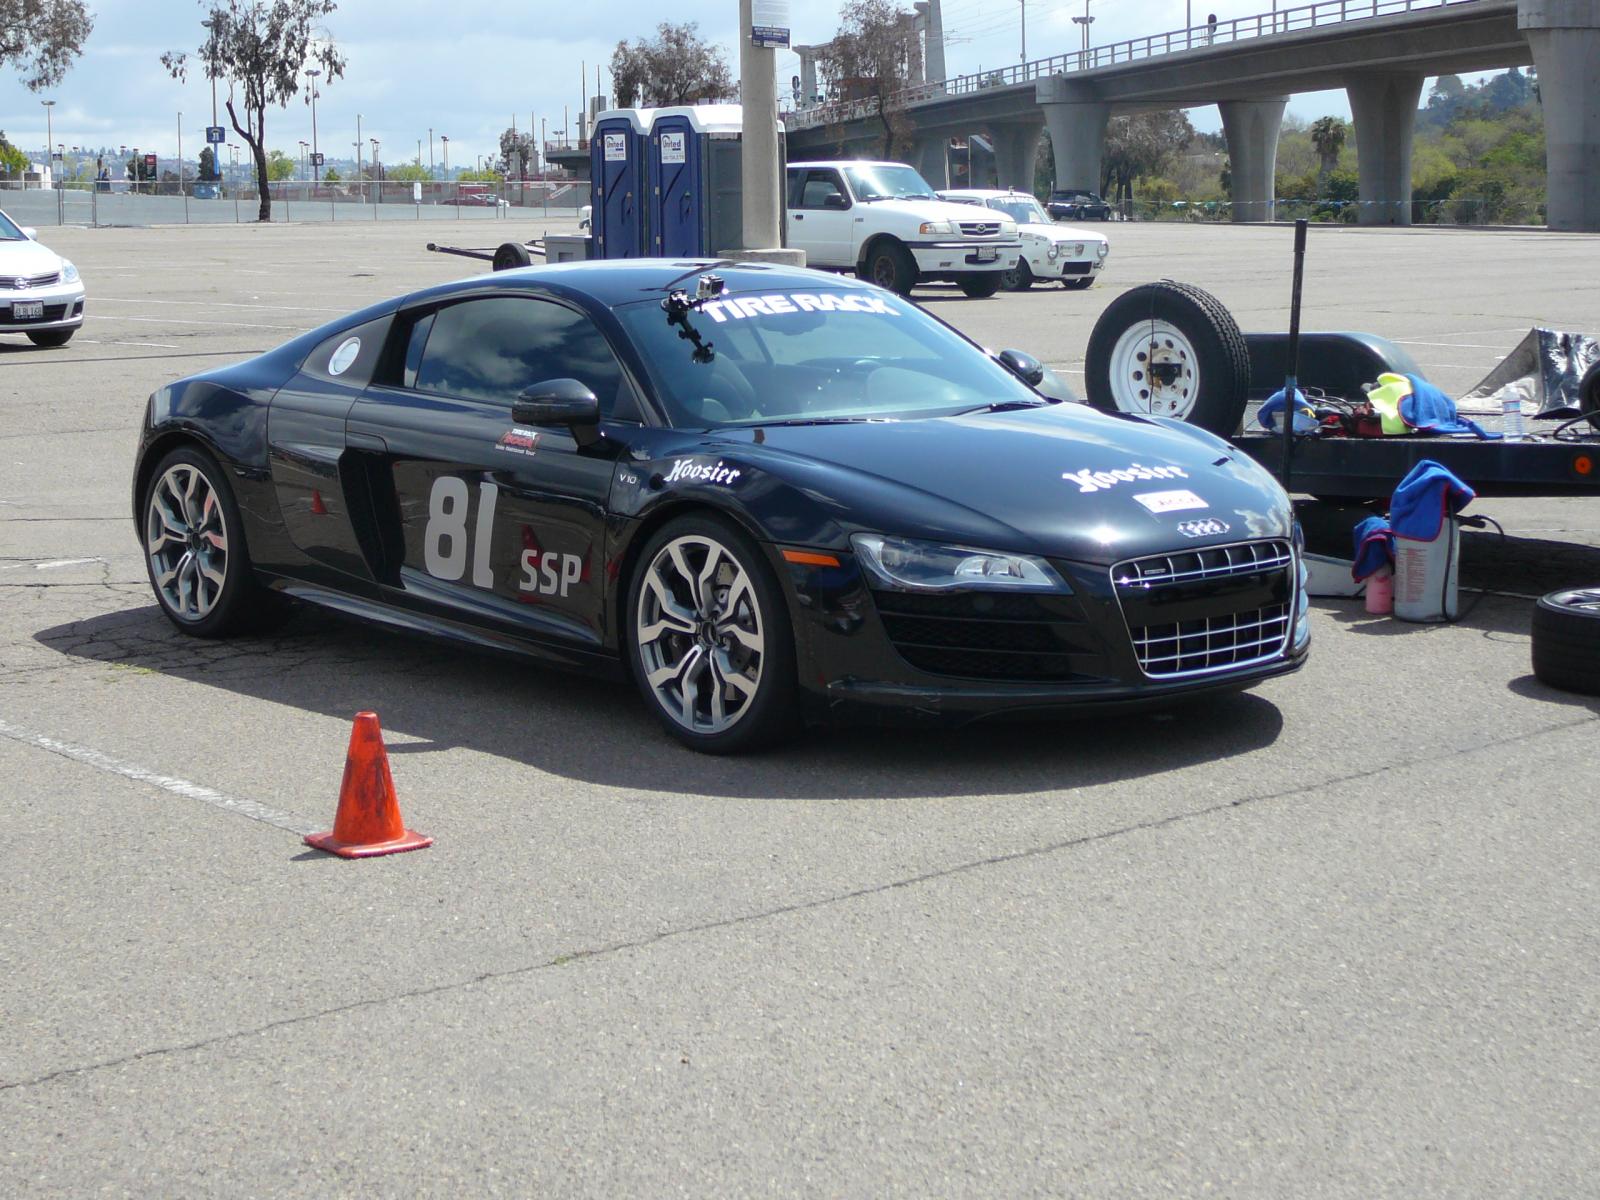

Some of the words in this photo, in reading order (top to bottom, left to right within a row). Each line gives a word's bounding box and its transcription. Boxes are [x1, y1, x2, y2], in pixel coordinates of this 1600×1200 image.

[663, 139, 681, 149] United
[695, 295, 798, 323] TIRE
[790, 294, 901, 316] RACK
[663, 459, 741, 485] Hoosier
[1062, 463, 1189, 493] Hoosier
[424, 476, 498, 589] 81
[519, 549, 582, 597] SSP
